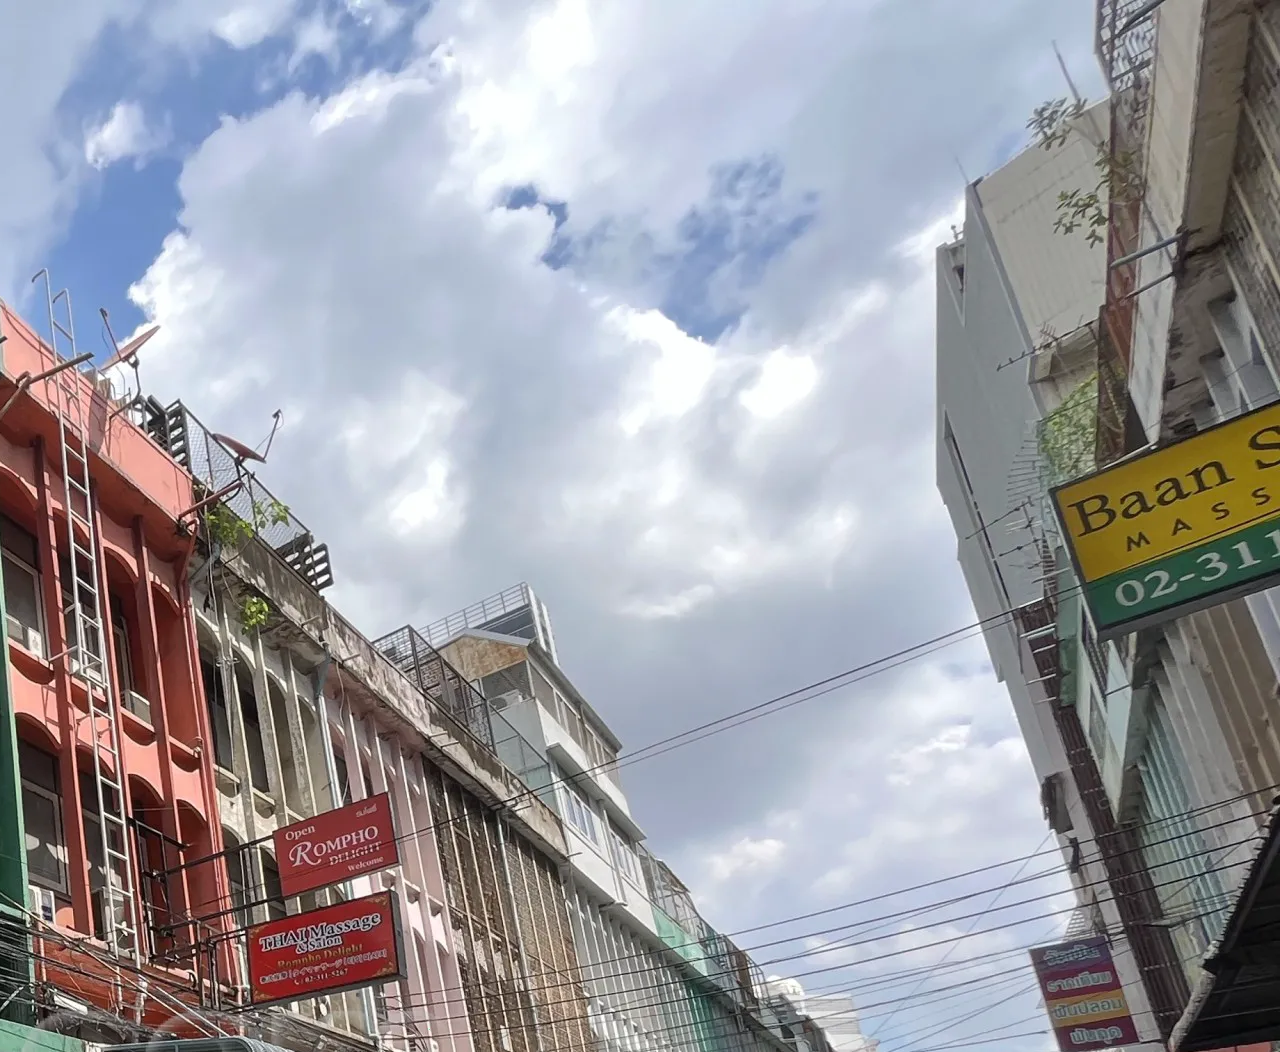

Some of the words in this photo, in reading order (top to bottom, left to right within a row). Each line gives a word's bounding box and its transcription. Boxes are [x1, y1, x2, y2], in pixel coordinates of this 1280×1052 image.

[1067, 460, 1235, 537] Baan
[285, 825, 316, 841] Open
[329, 841, 382, 865] DELIGHT
[347, 856, 384, 872] Welcome
[260, 928, 307, 952] THAI
[308, 913, 380, 940] Massage
[277, 953, 322, 968] Rompho
[323, 943, 363, 959] Delight
